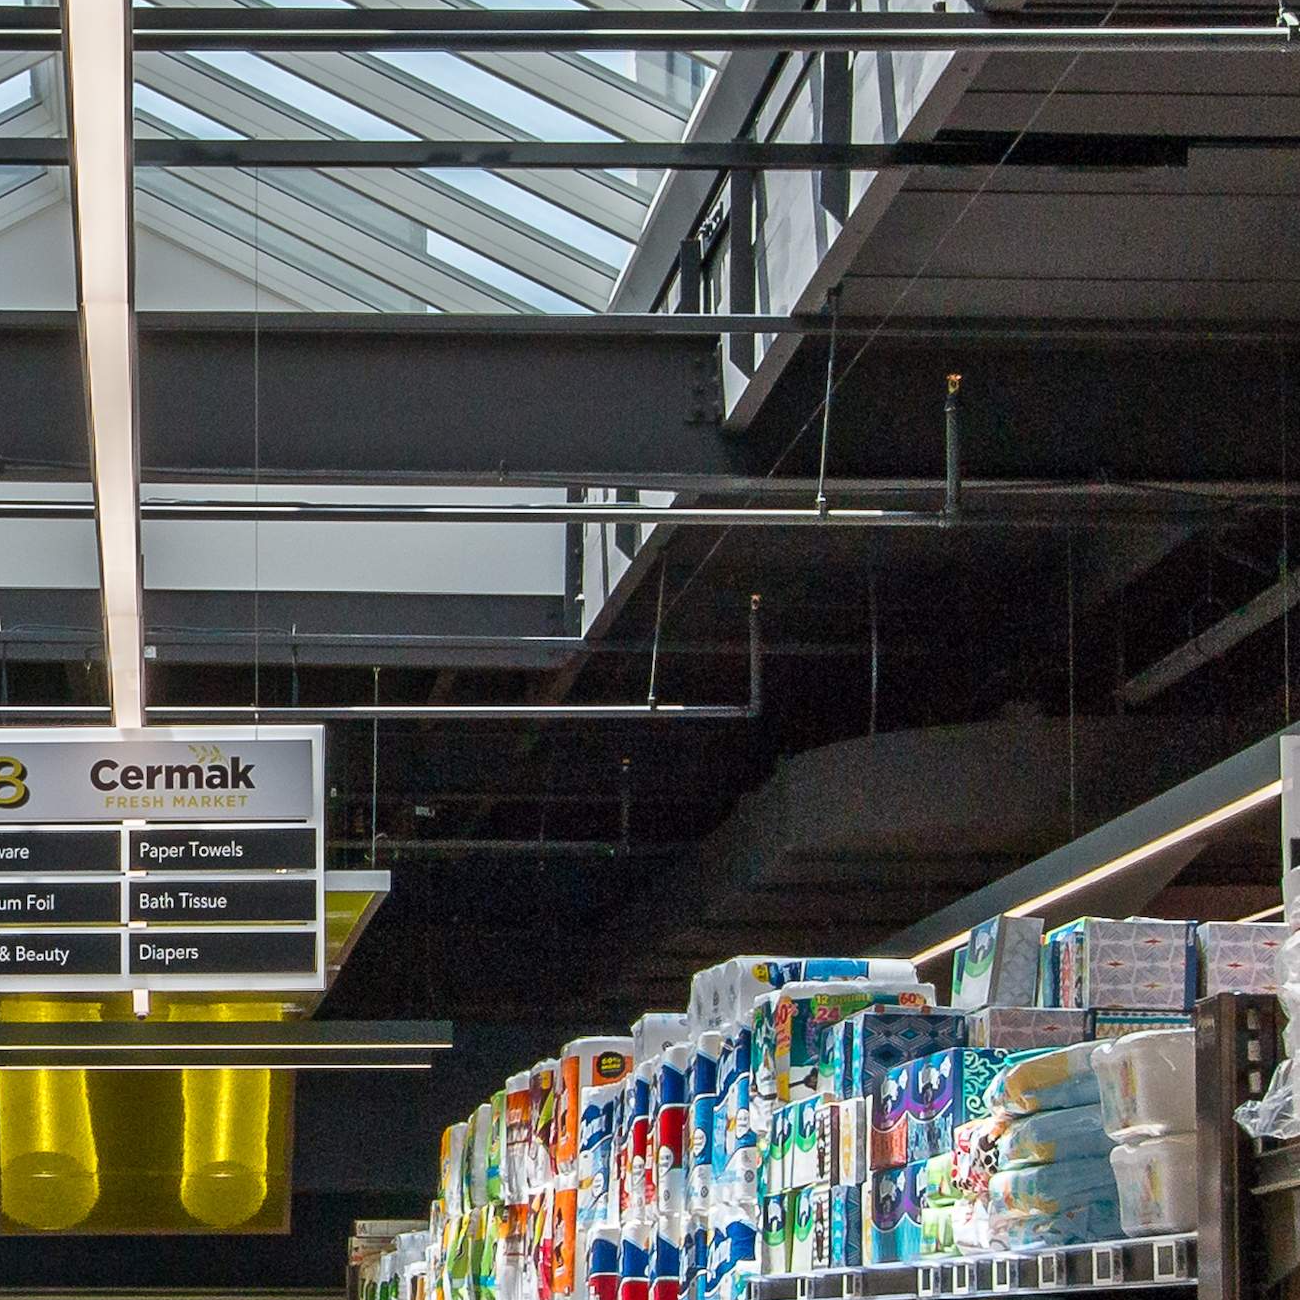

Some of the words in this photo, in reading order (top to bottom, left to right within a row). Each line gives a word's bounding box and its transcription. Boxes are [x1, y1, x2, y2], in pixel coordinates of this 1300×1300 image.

[90, 756, 256, 791] Cermak
[105, 796, 165, 809] FRESH
[173, 794, 249, 808] MARKET
[139, 842, 185, 861] Paper
[189, 841, 244, 858] Towels
[27, 894, 55, 911] Foil
[139, 893, 174, 909] Bath
[178, 893, 227, 909] Tissue
[15, 946, 70, 966] Beauty
[139, 945, 199, 962] Diapers
